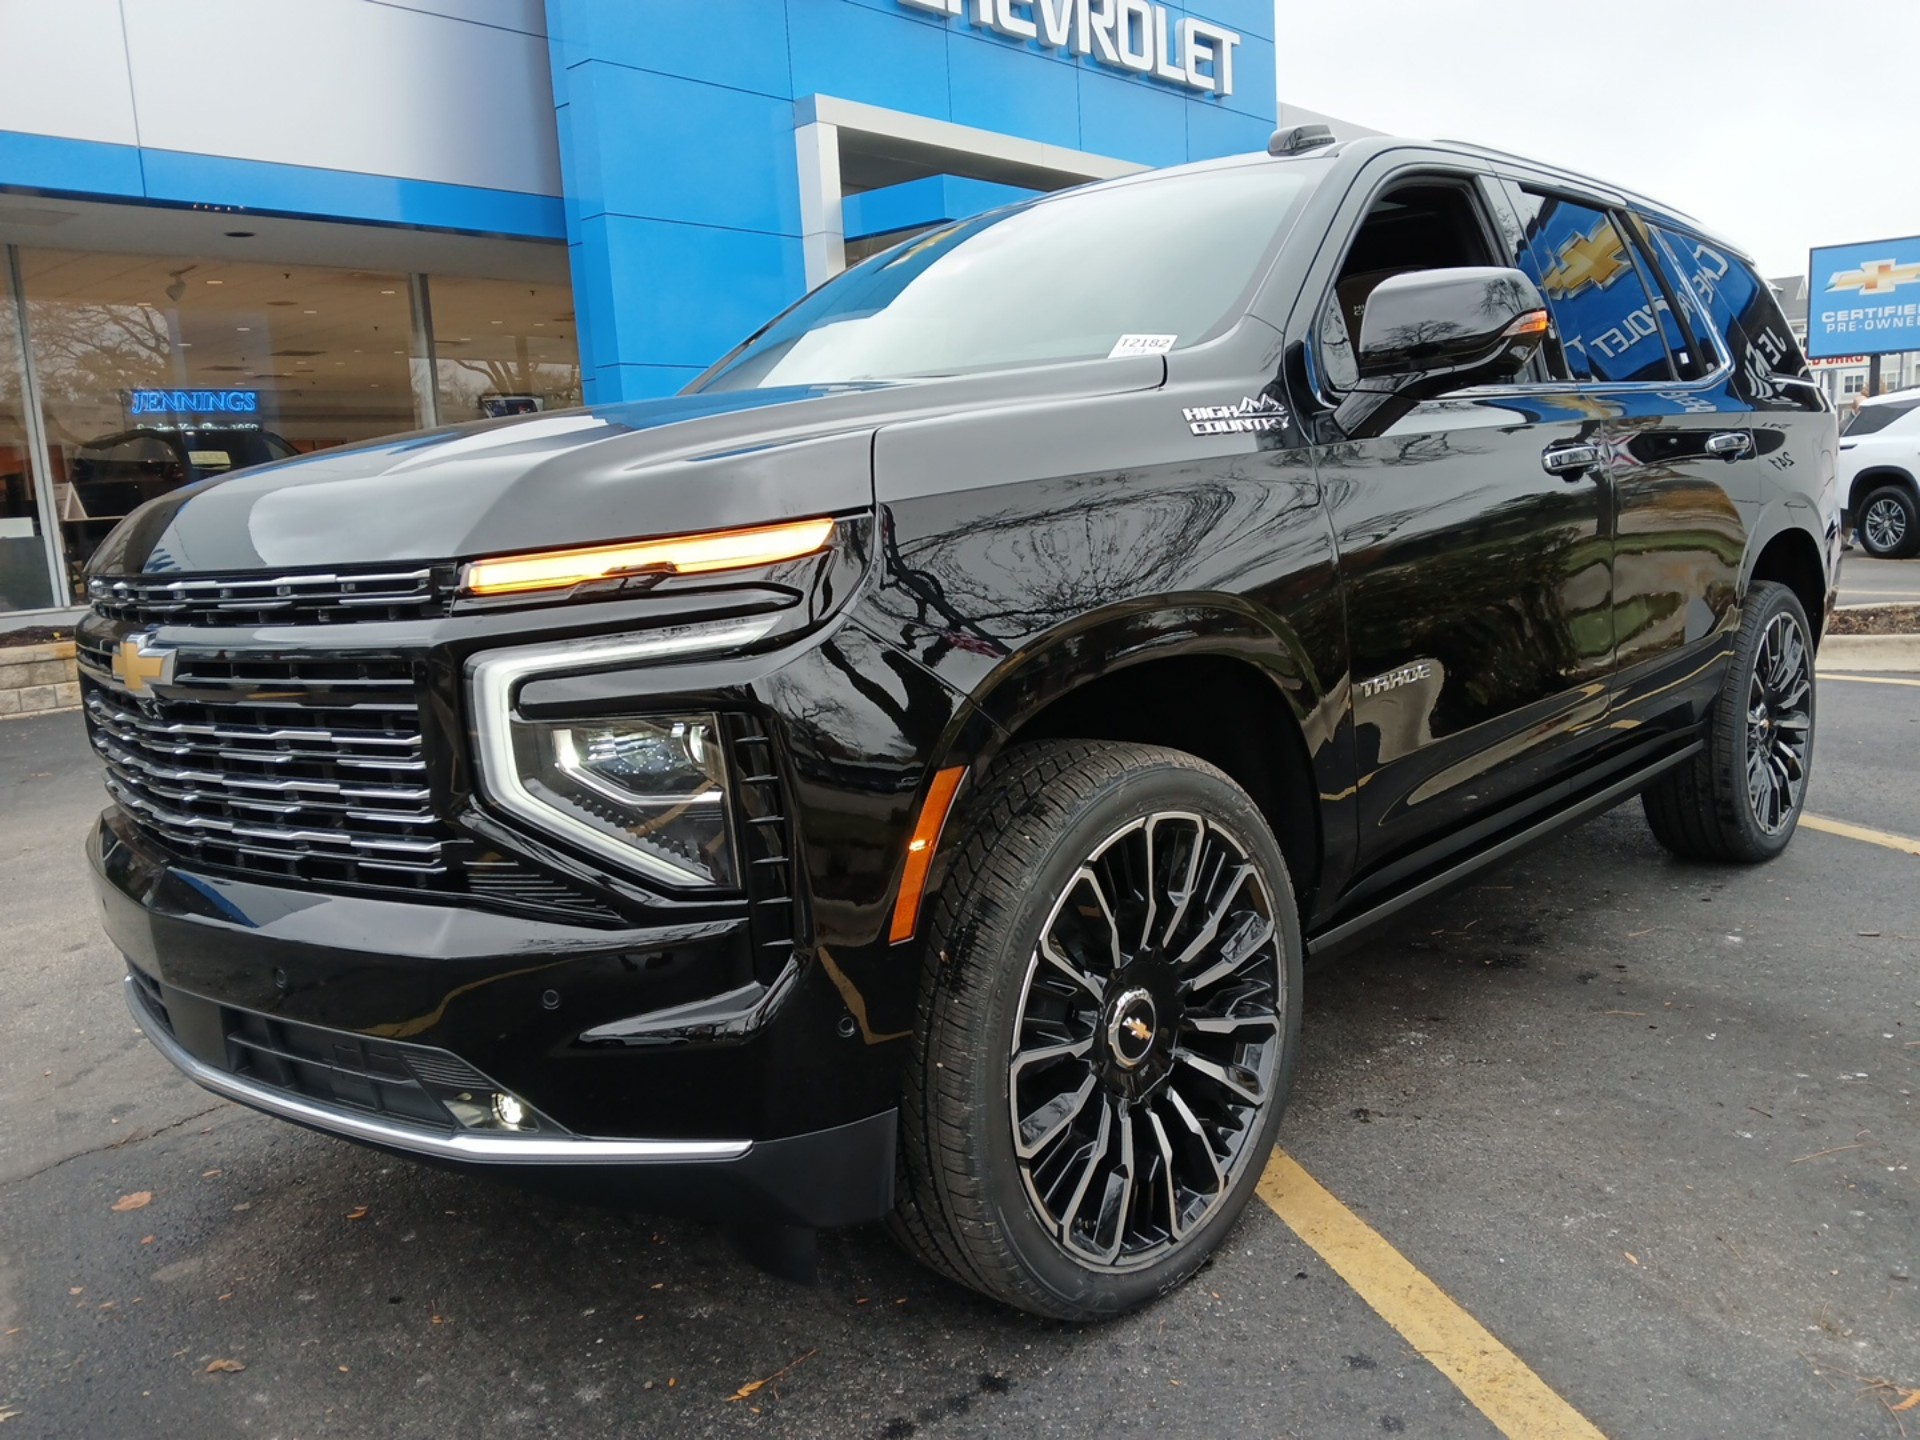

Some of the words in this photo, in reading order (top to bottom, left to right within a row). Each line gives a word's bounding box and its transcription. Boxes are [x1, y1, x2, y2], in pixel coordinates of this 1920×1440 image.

[895, 0, 1241, 97] EVROLET
[1821, 304, 1920, 323] CERTIFIE
[1826, 316, 1920, 334] PRE-OWNE
[131, 391, 257, 413] JENNINGS
[1182, 405, 1241, 421] HIGH
[1190, 416, 1290, 435] COUNTRY
[1359, 663, 1431, 697] TAHOE
